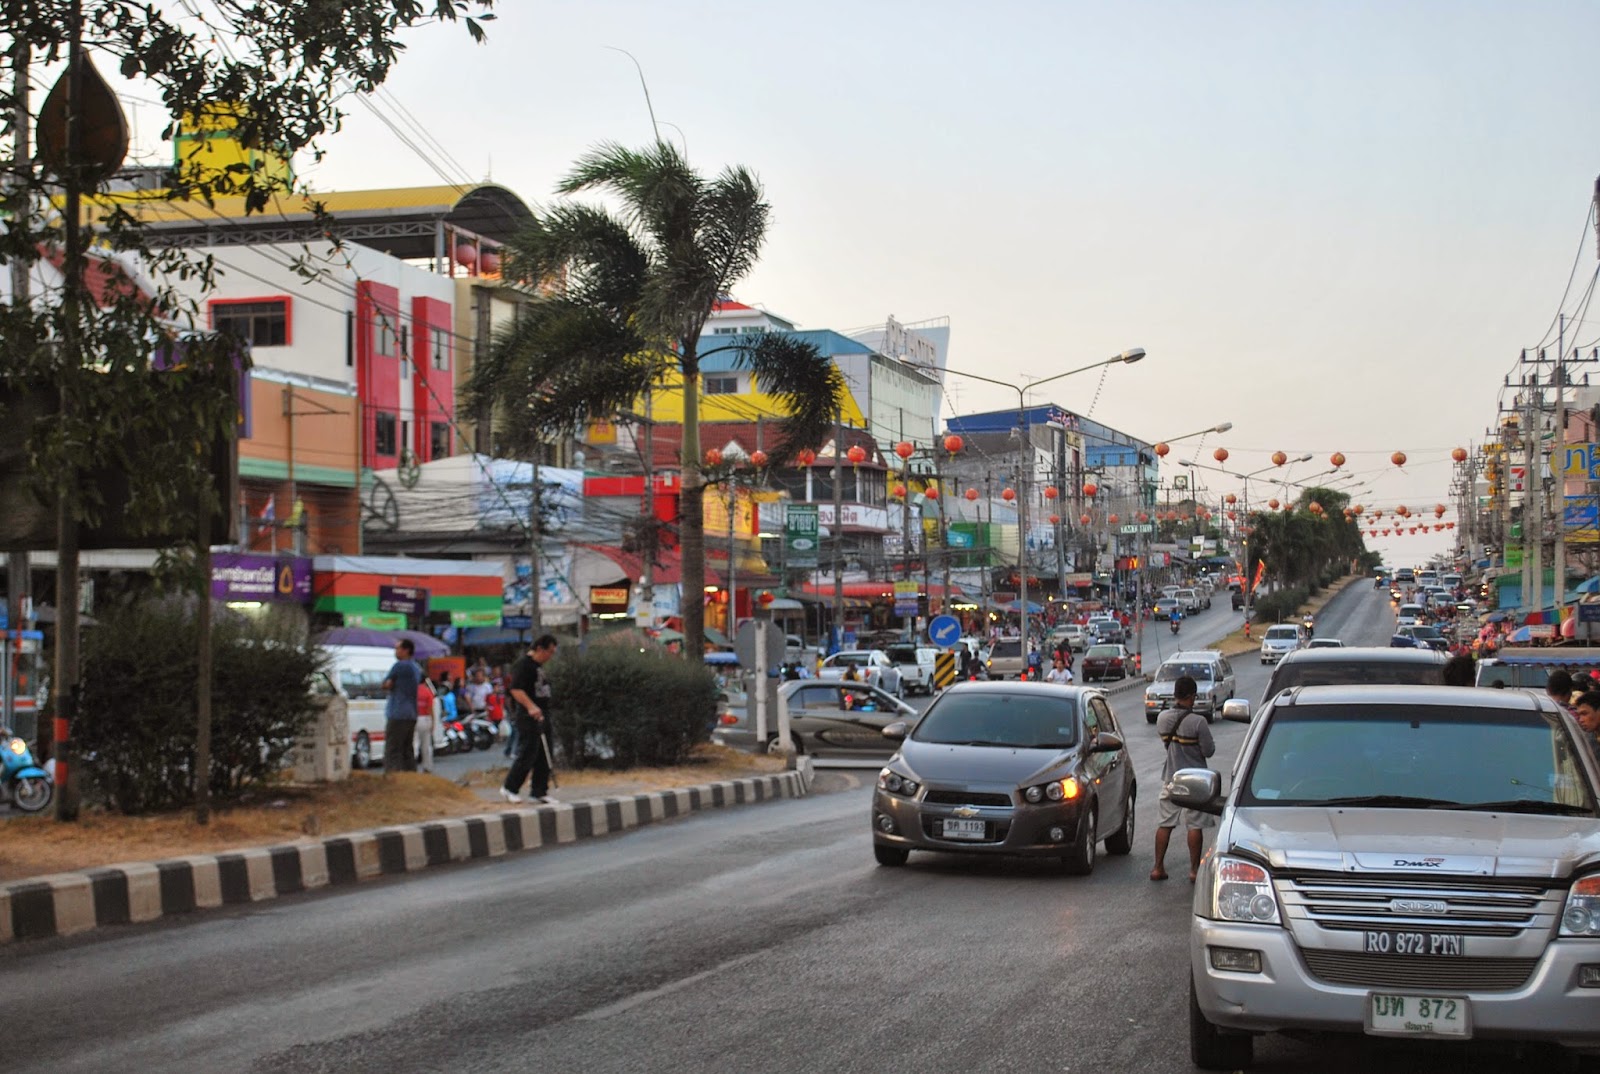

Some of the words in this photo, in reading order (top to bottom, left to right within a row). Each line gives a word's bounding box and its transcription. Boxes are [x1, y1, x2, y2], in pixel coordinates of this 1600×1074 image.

[1392, 901, 1445, 912] ISUZU
[1367, 931, 1390, 952] RO
[1395, 932, 1424, 954] 872
[1430, 933, 1461, 955] PTN
[1418, 998, 1457, 1020] 872
